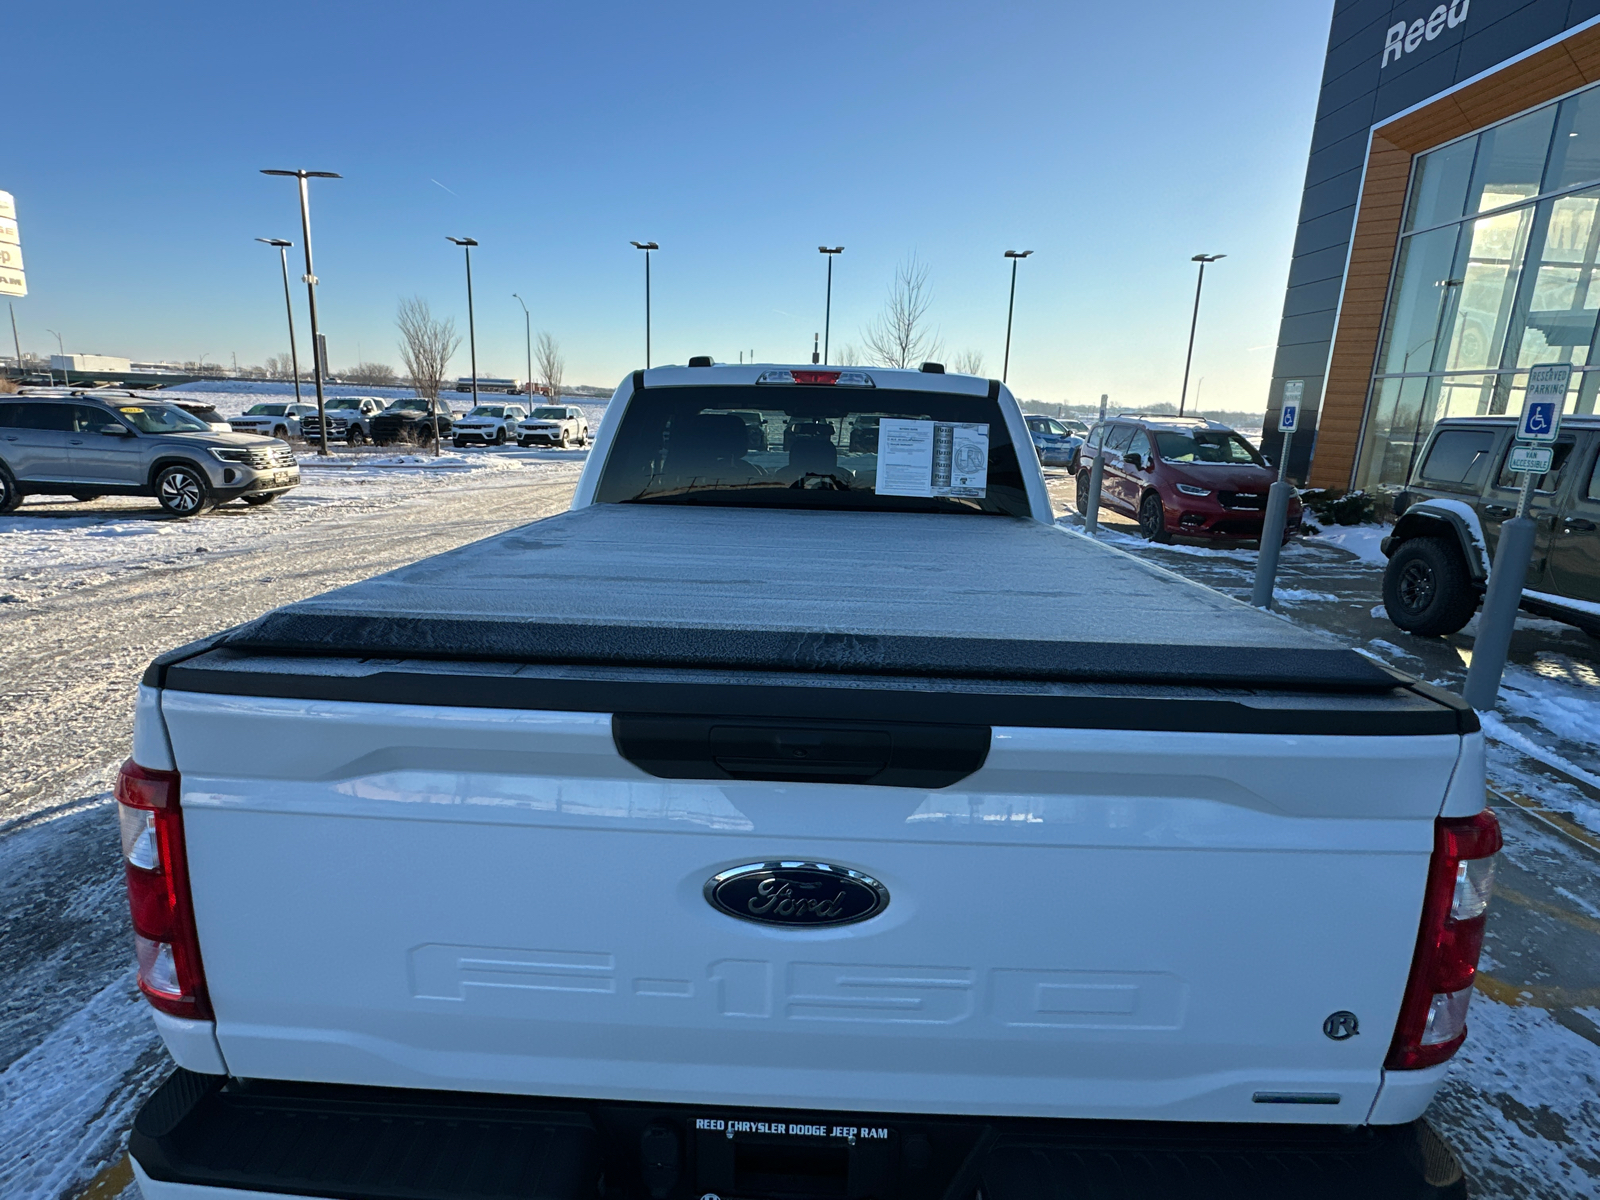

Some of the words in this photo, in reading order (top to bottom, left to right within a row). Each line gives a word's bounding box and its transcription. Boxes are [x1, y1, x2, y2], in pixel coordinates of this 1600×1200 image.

[1381, 0, 1470, 68] Reed
[1531, 370, 1567, 381] RESERVED
[1528, 384, 1564, 395] PARKING
[1525, 451, 1538, 459] VAN
[1511, 459, 1548, 469] ACCESSIBLE
[748, 878, 846, 917] Ford
[407, 943, 1188, 1033] F-150
[696, 1118, 725, 1130] REED
[728, 1120, 786, 1134] CHRYSLER
[789, 1124, 827, 1136] DODGE
[830, 1126, 857, 1138] JEEP
[860, 1128, 888, 1139] RAM
